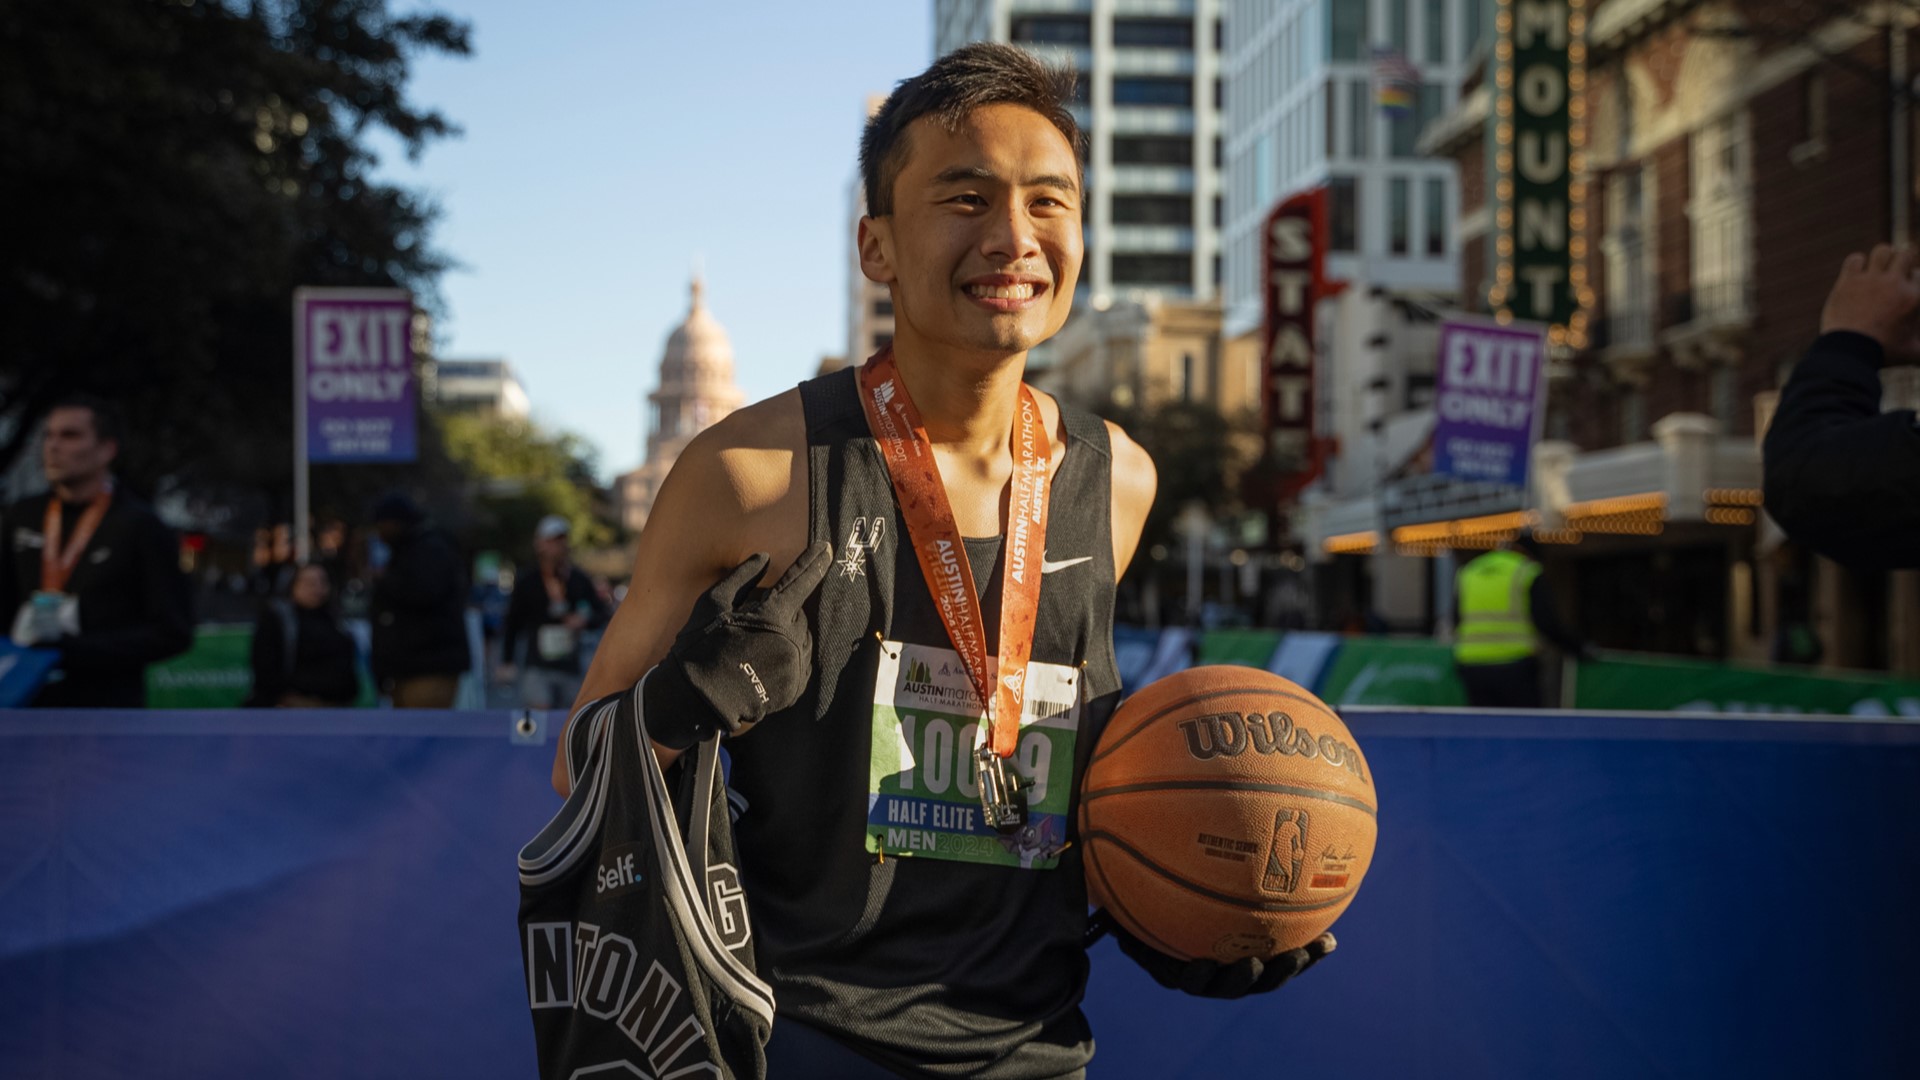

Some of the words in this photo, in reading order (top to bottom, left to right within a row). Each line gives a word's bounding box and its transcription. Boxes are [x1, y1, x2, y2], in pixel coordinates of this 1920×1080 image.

[312, 309, 407, 366] EXIT
[1271, 215, 1312, 473] STATE
[1445, 331, 1536, 394] EXIT
[310, 371, 407, 401] ONLY
[1440, 392, 1530, 429] ONLY
[1036, 456, 1047, 473] TX
[1011, 401, 1034, 584] AUSTINHALFMARATHON
[940, 595, 957, 627] 2024
[743, 662, 769, 703] HEAD
[903, 682, 981, 702] AUSTINmara
[895, 715, 1052, 806] 1009
[1177, 711, 1368, 785] Wilson
[888, 799, 928, 825] HALF
[933, 804, 975, 831] ELITE
[888, 828, 937, 851] MEN
[597, 852, 642, 894] Self.
[1266, 873, 1288, 890] NBA
